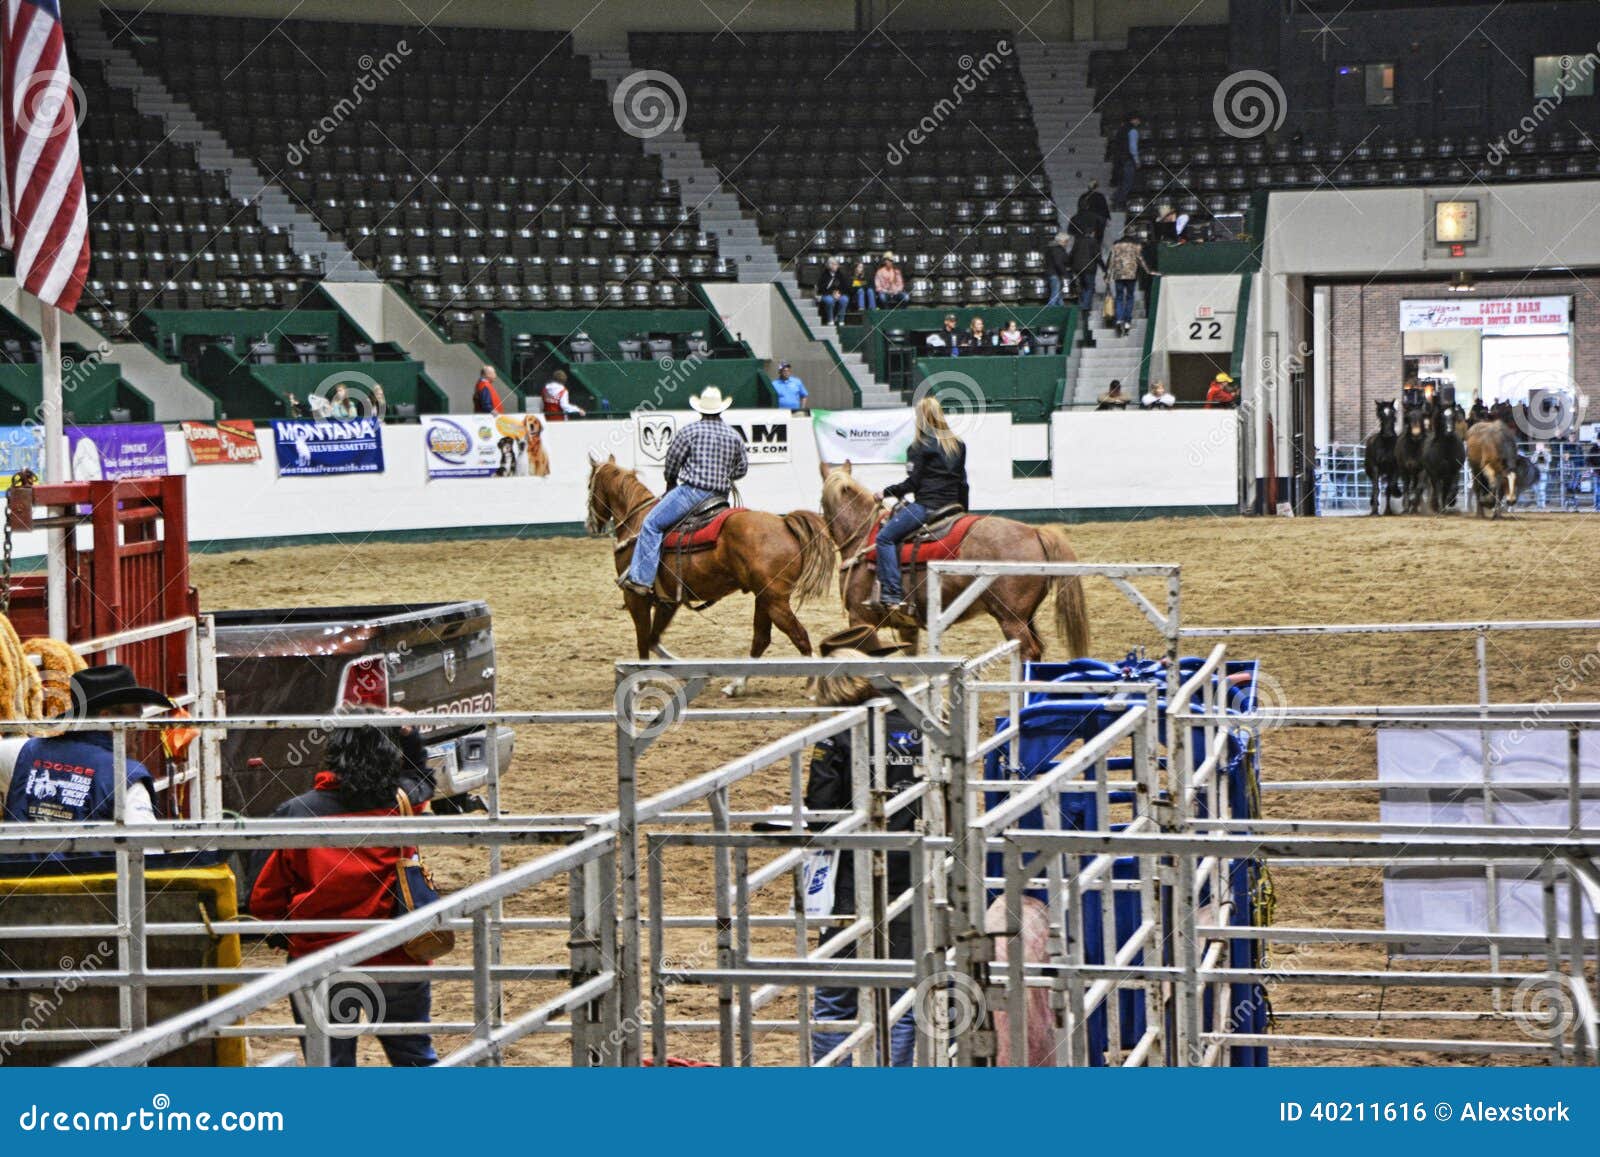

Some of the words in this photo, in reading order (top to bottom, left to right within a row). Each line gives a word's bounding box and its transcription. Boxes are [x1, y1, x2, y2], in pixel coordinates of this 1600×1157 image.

[1479, 303, 1512, 314] CATTLE
[1516, 301, 1541, 313] BARN
[1189, 321, 1222, 340] 22
[276, 420, 376, 441] MONTANA
[849, 429, 890, 438] Nutrena
[309, 442, 377, 453] SILVERSMITHS
[71, 773, 93, 786] TEXAS
